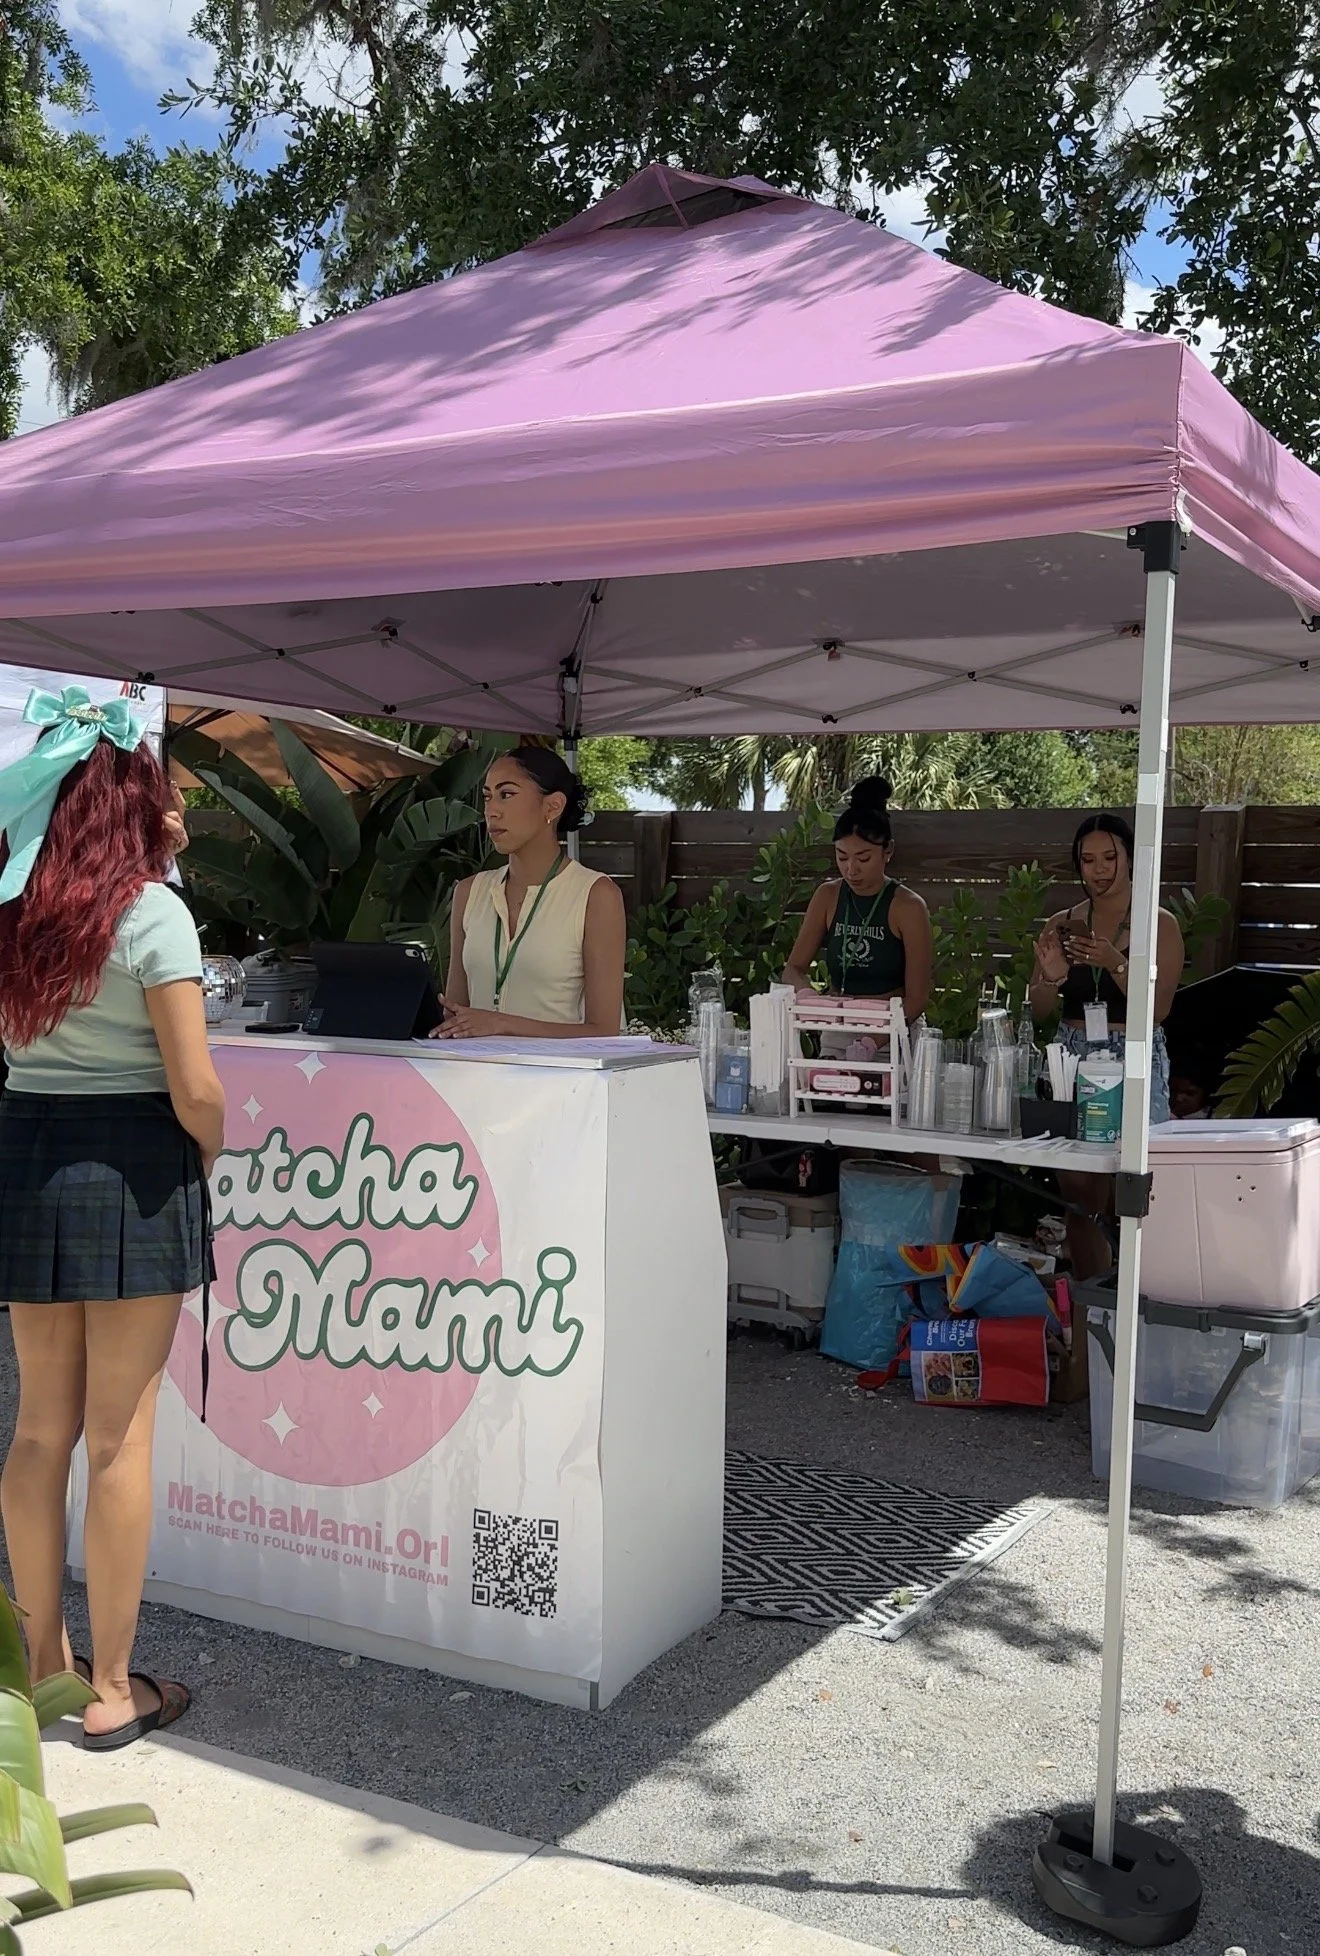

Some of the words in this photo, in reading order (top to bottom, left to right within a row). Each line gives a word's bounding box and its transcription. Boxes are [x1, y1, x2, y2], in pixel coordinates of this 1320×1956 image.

[120, 681, 147, 701] ABC
[863, 926, 885, 941] HILLS
[211, 1112, 479, 1231] atcha
[224, 1238, 584, 1377] Mami
[957, 1329, 966, 1348] Our
[168, 1481, 449, 1568] MatchaMami.Orl
[168, 1515, 202, 1532] SCAN
[206, 1523, 239, 1540] HERE
[243, 1531, 259, 1545] TO
[263, 1535, 317, 1557] FOLLOW
[321, 1547, 338, 1562] US
[342, 1553, 362, 1567] ON
[367, 1557, 449, 1586] INSTAGRAM
